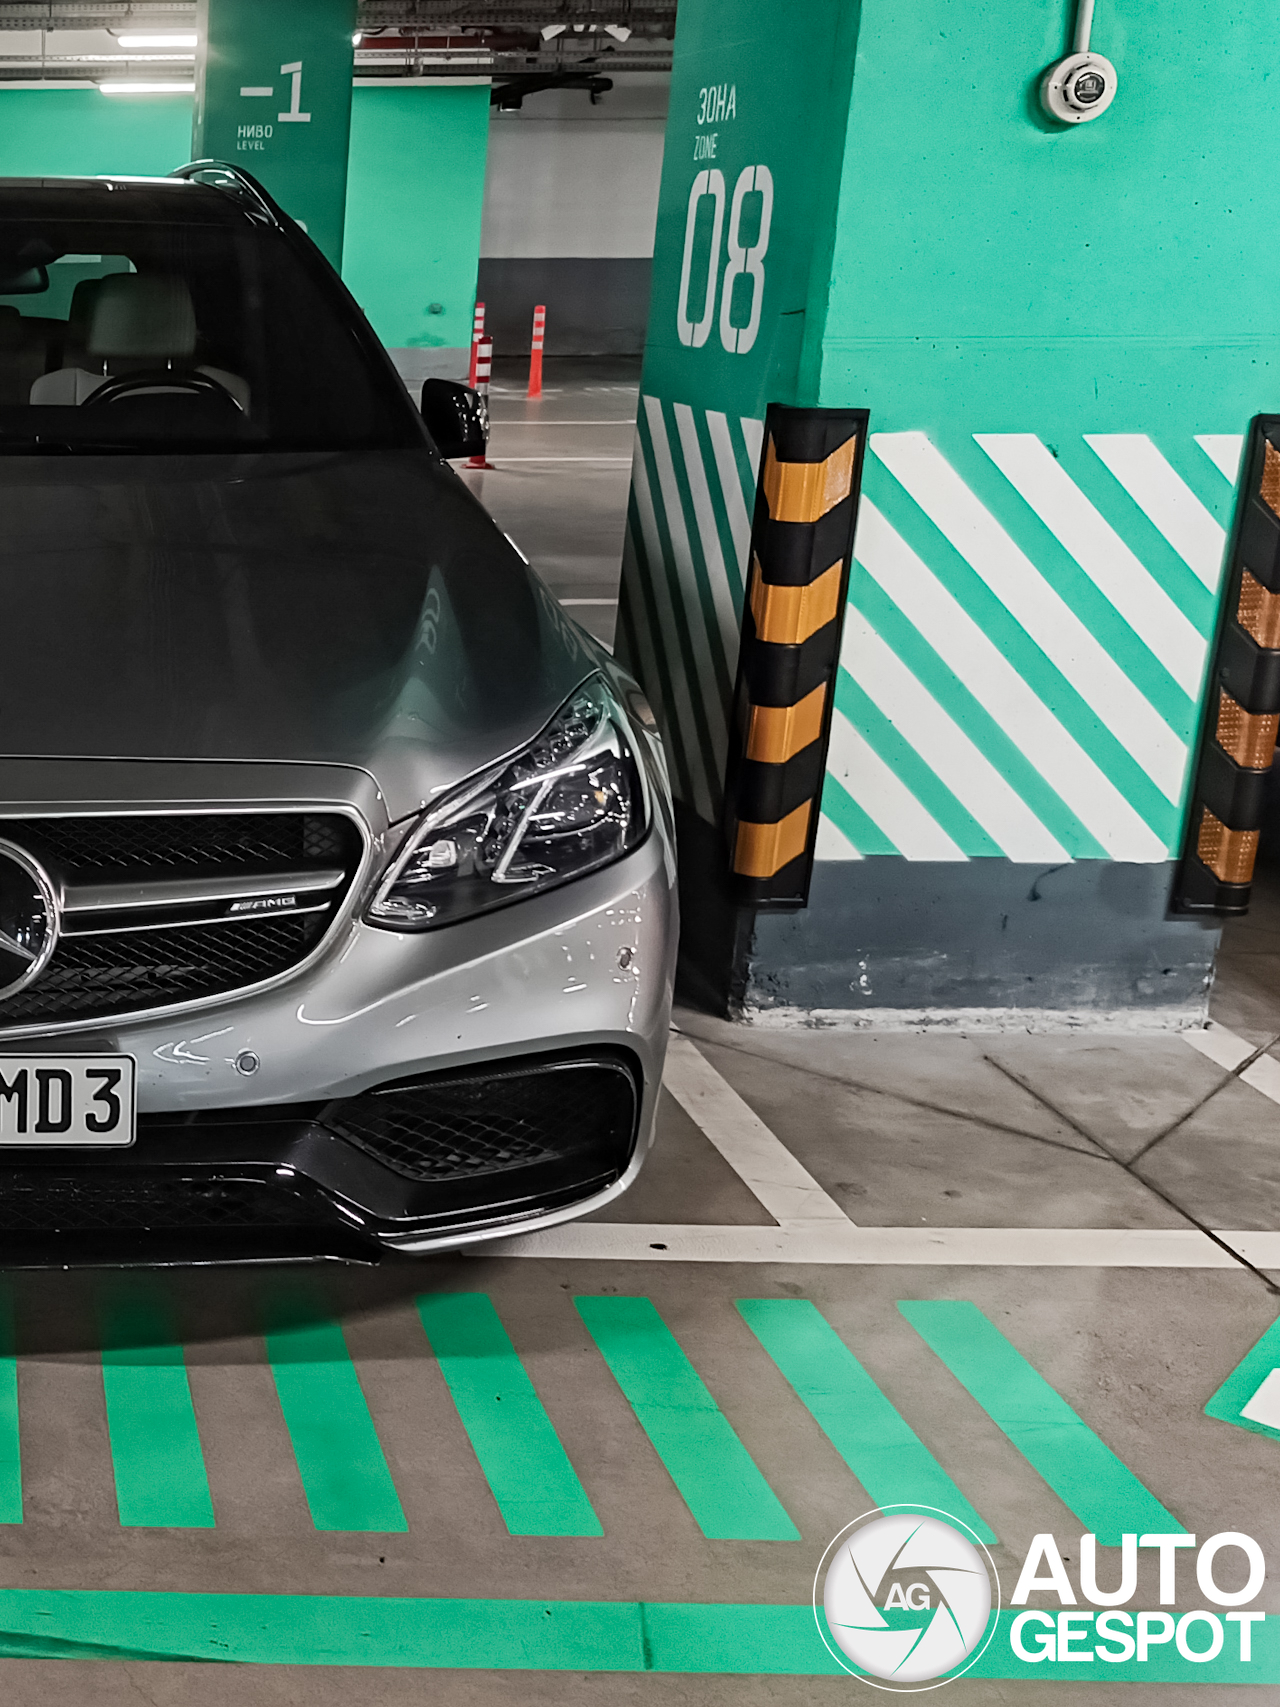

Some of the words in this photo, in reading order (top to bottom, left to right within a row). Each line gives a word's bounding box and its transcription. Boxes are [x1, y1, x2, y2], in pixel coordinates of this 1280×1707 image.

[240, 61, 311, 122] -1
[697, 83, 737, 125] ЗОНА
[237, 140, 265, 150] LEVEL
[238, 125, 273, 138] НИВО
[693, 133, 718, 161] ZONE
[677, 165, 774, 354] 08
